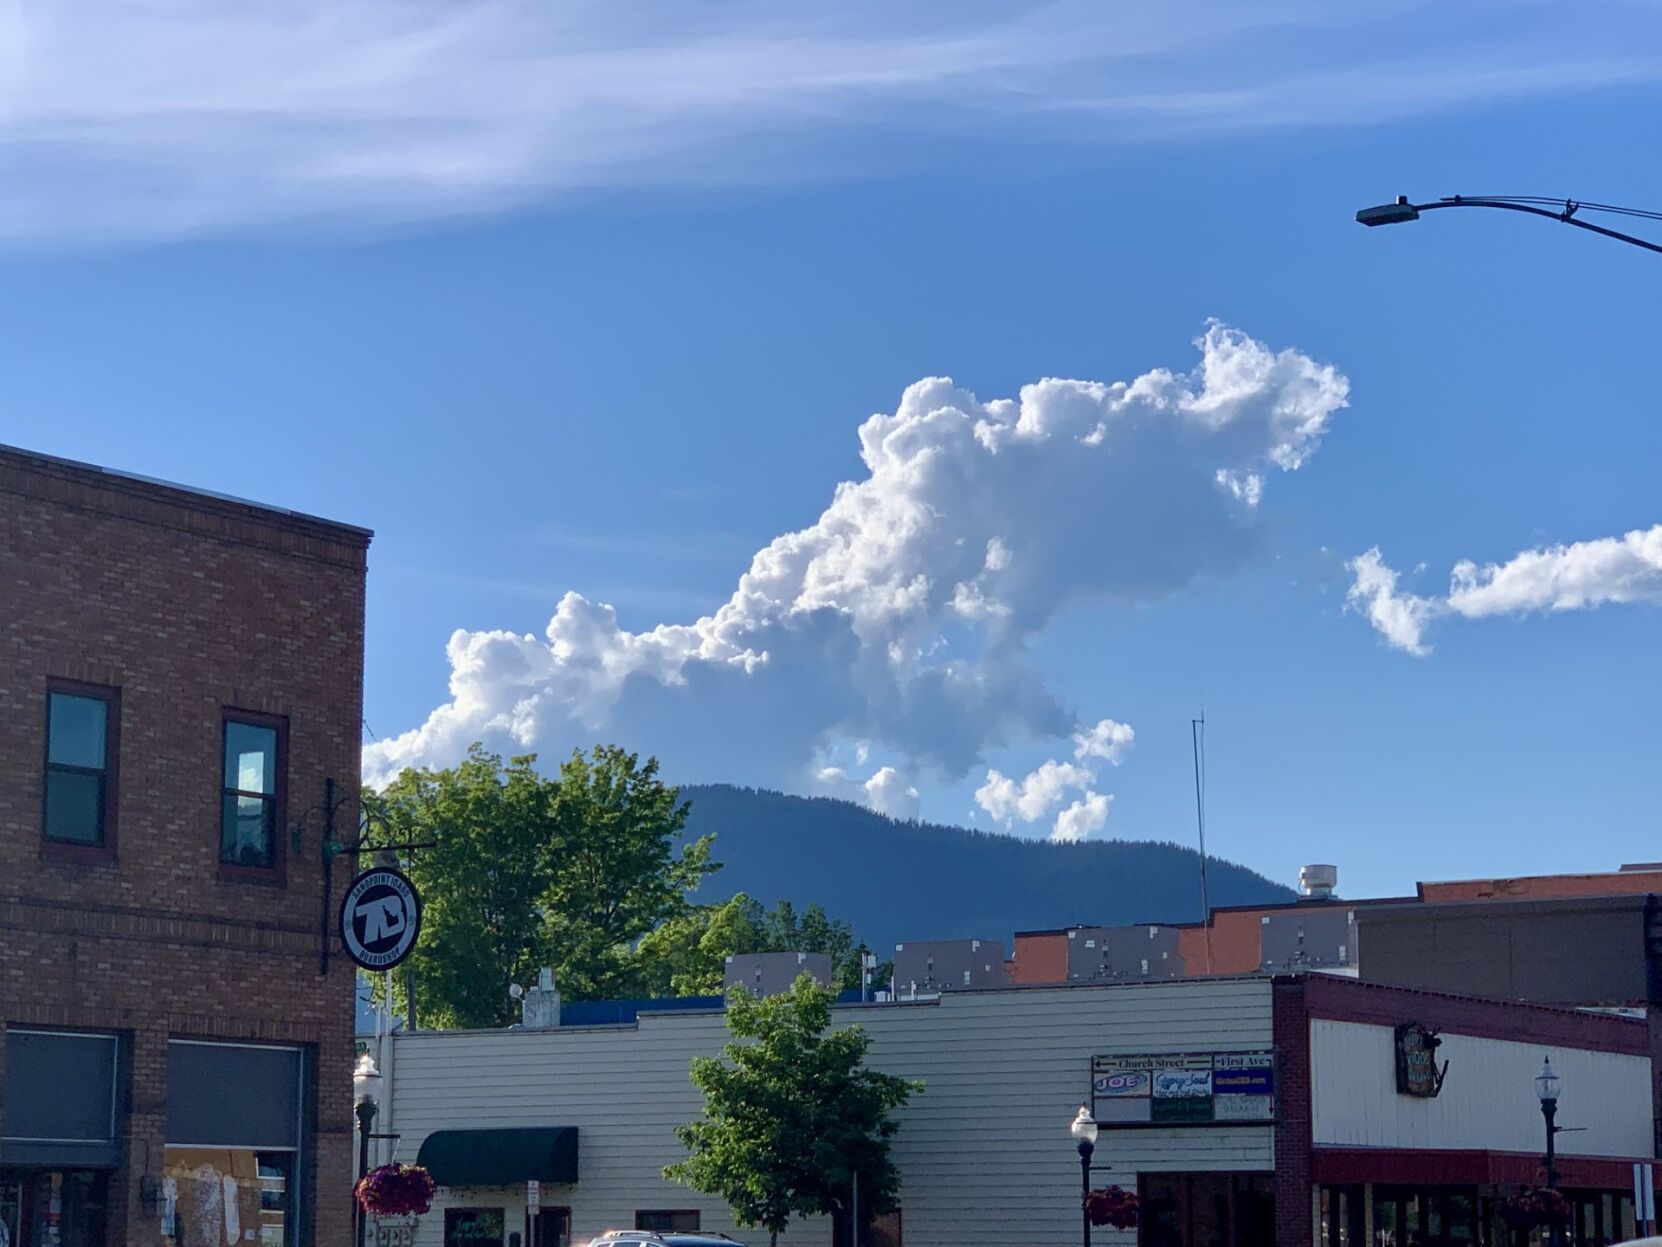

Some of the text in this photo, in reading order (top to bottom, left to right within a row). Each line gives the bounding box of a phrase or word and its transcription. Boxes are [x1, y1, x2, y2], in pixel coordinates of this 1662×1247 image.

[352, 874, 410, 899] SANDPOINT IDAHO
[359, 946, 400, 964] BOARDSHOP
[1119, 1058, 1184, 1068] Church Street
[1221, 1056, 1243, 1066] First
